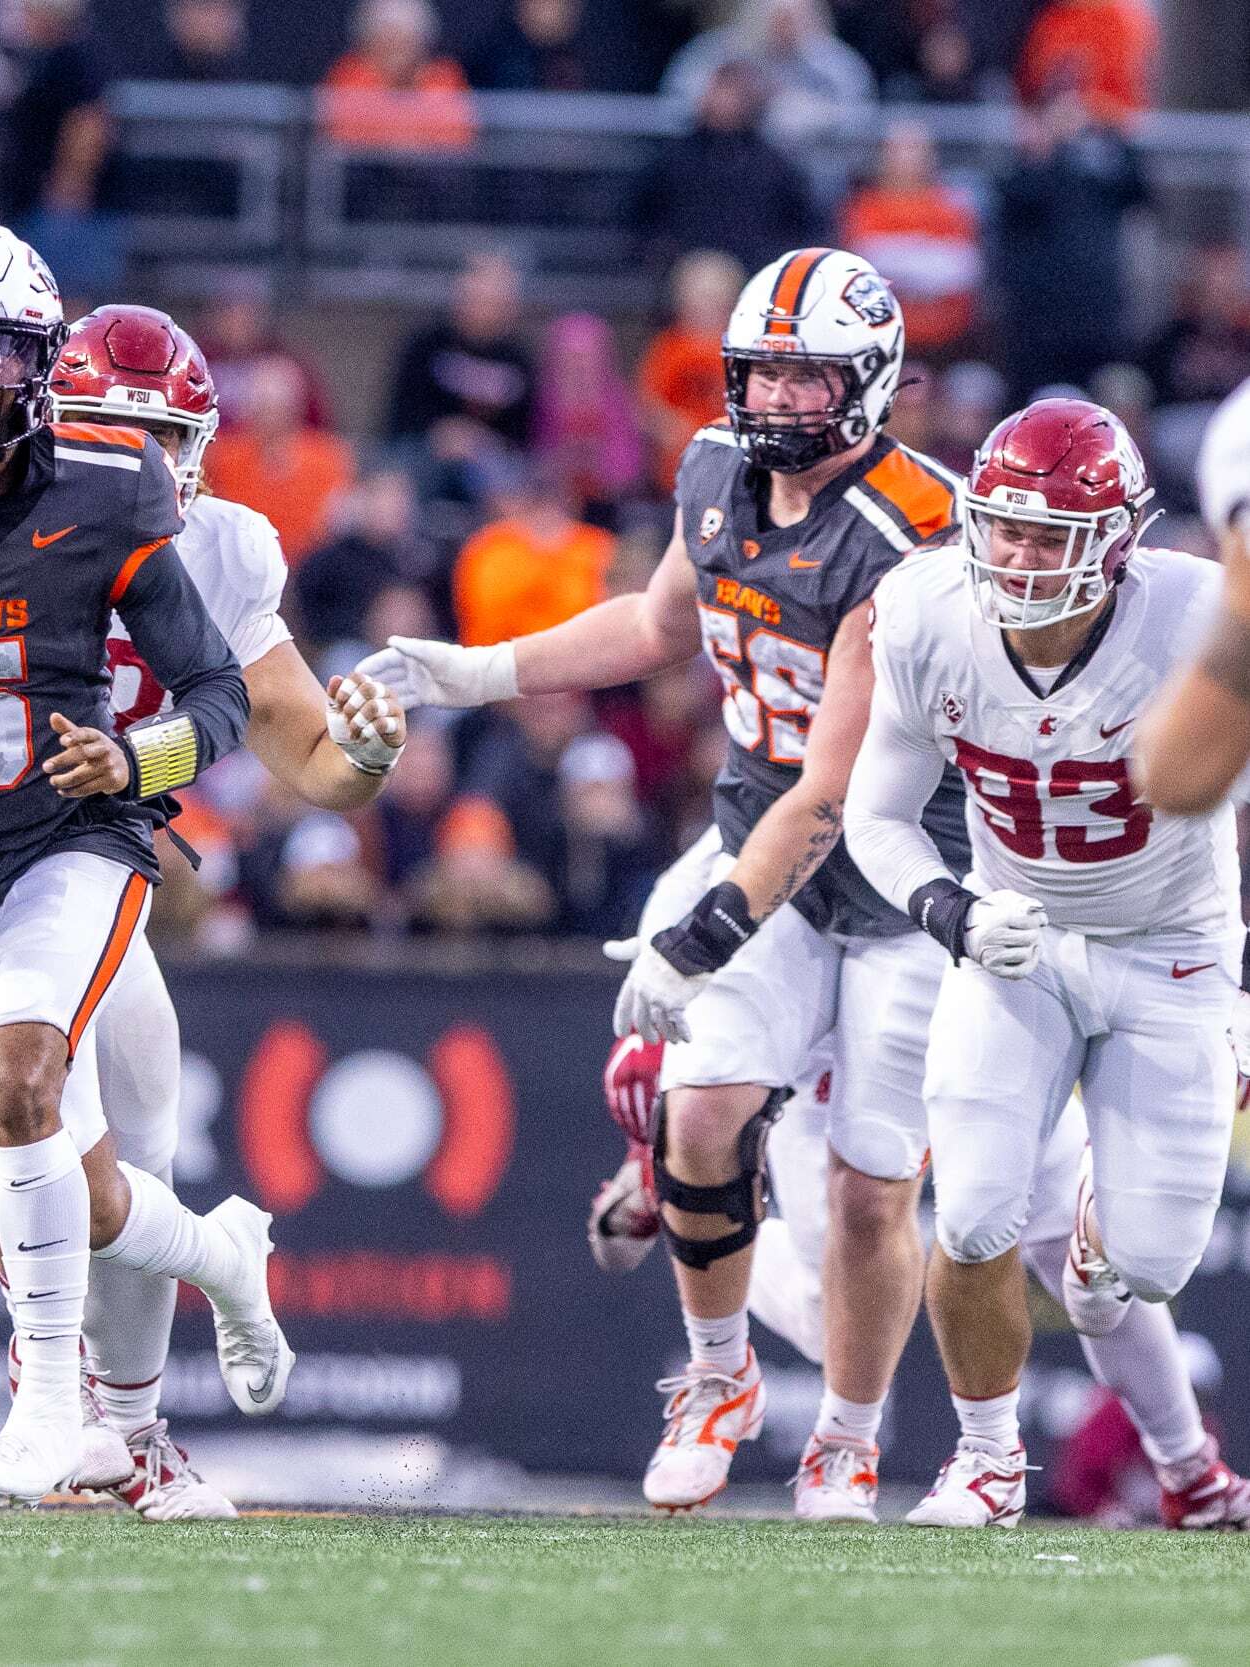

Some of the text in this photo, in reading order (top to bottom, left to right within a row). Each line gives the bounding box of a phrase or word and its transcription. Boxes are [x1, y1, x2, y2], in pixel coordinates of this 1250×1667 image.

[126, 388, 151, 404] WSU
[1005, 490, 1029, 506] WSU
[943, 734, 1155, 864] 93
